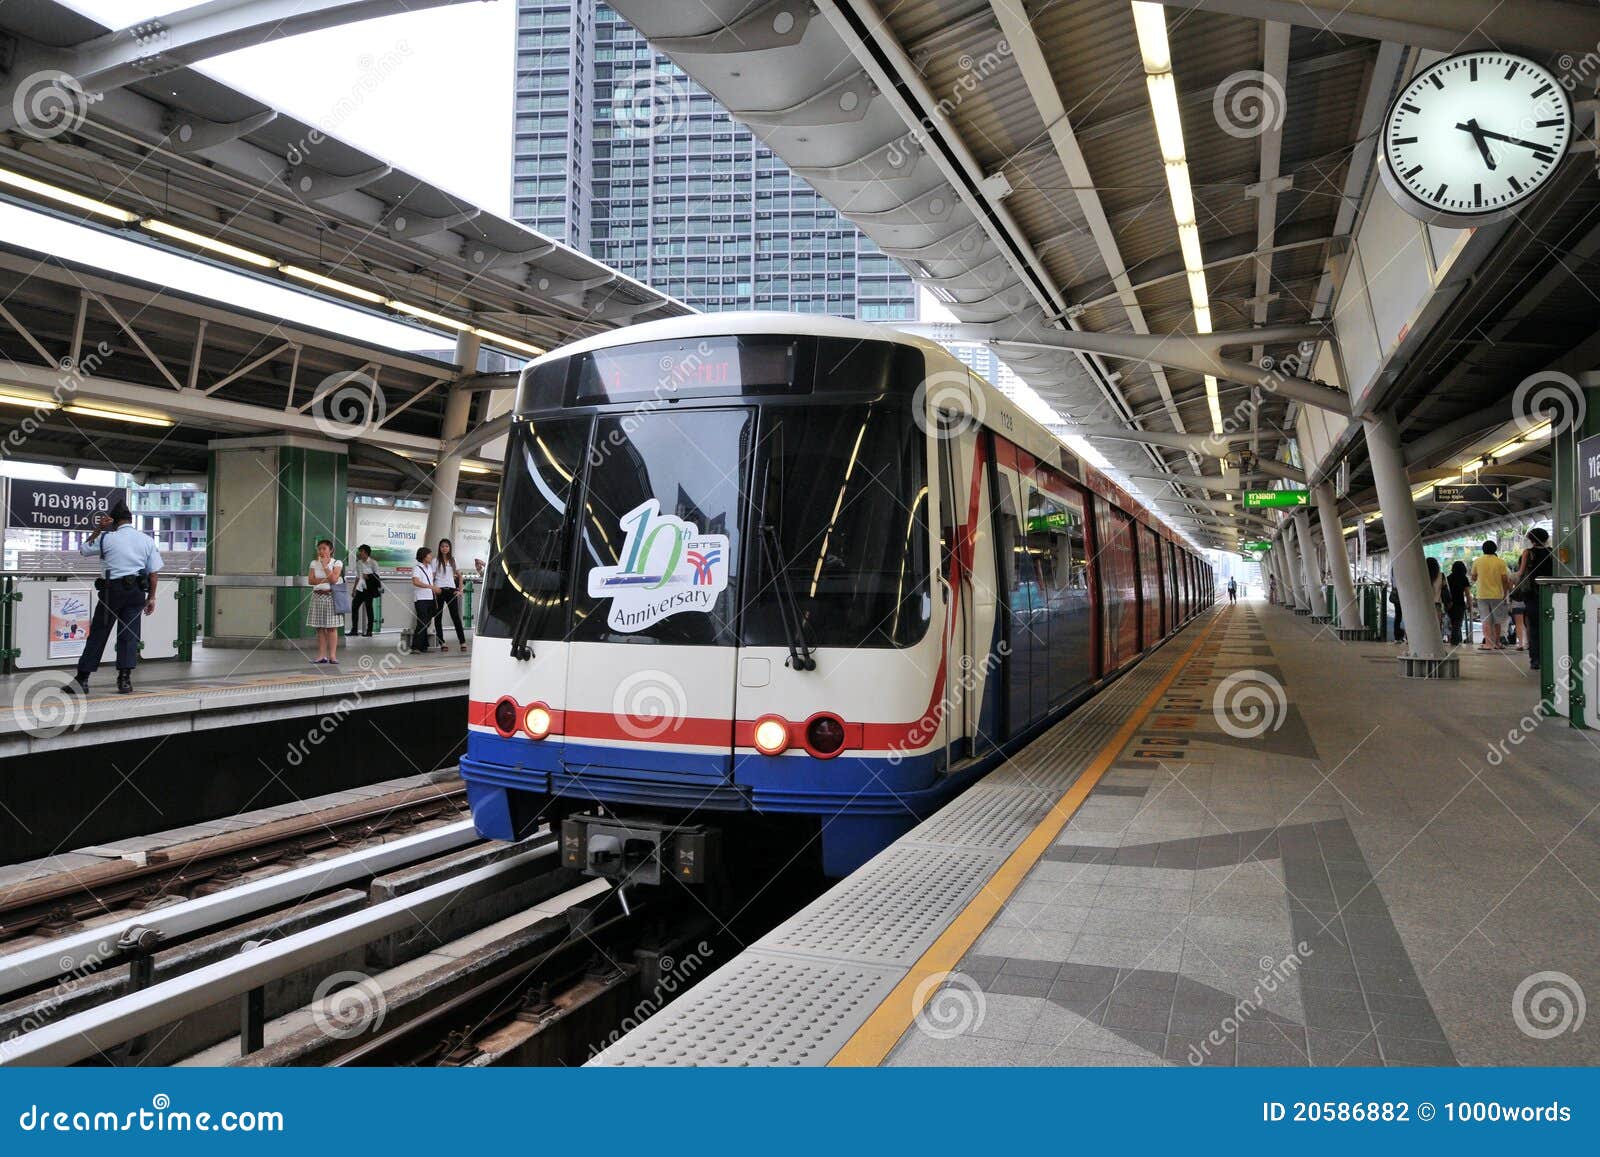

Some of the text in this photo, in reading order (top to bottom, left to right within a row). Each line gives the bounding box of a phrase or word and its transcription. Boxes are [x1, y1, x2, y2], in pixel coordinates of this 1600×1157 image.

[32, 491, 109, 511] ทองหล่อ
[31, 512, 71, 526] Thong
[74, 514, 89, 525] Lo
[687, 541, 721, 549] BTS
[614, 589, 711, 626] Anniversary
